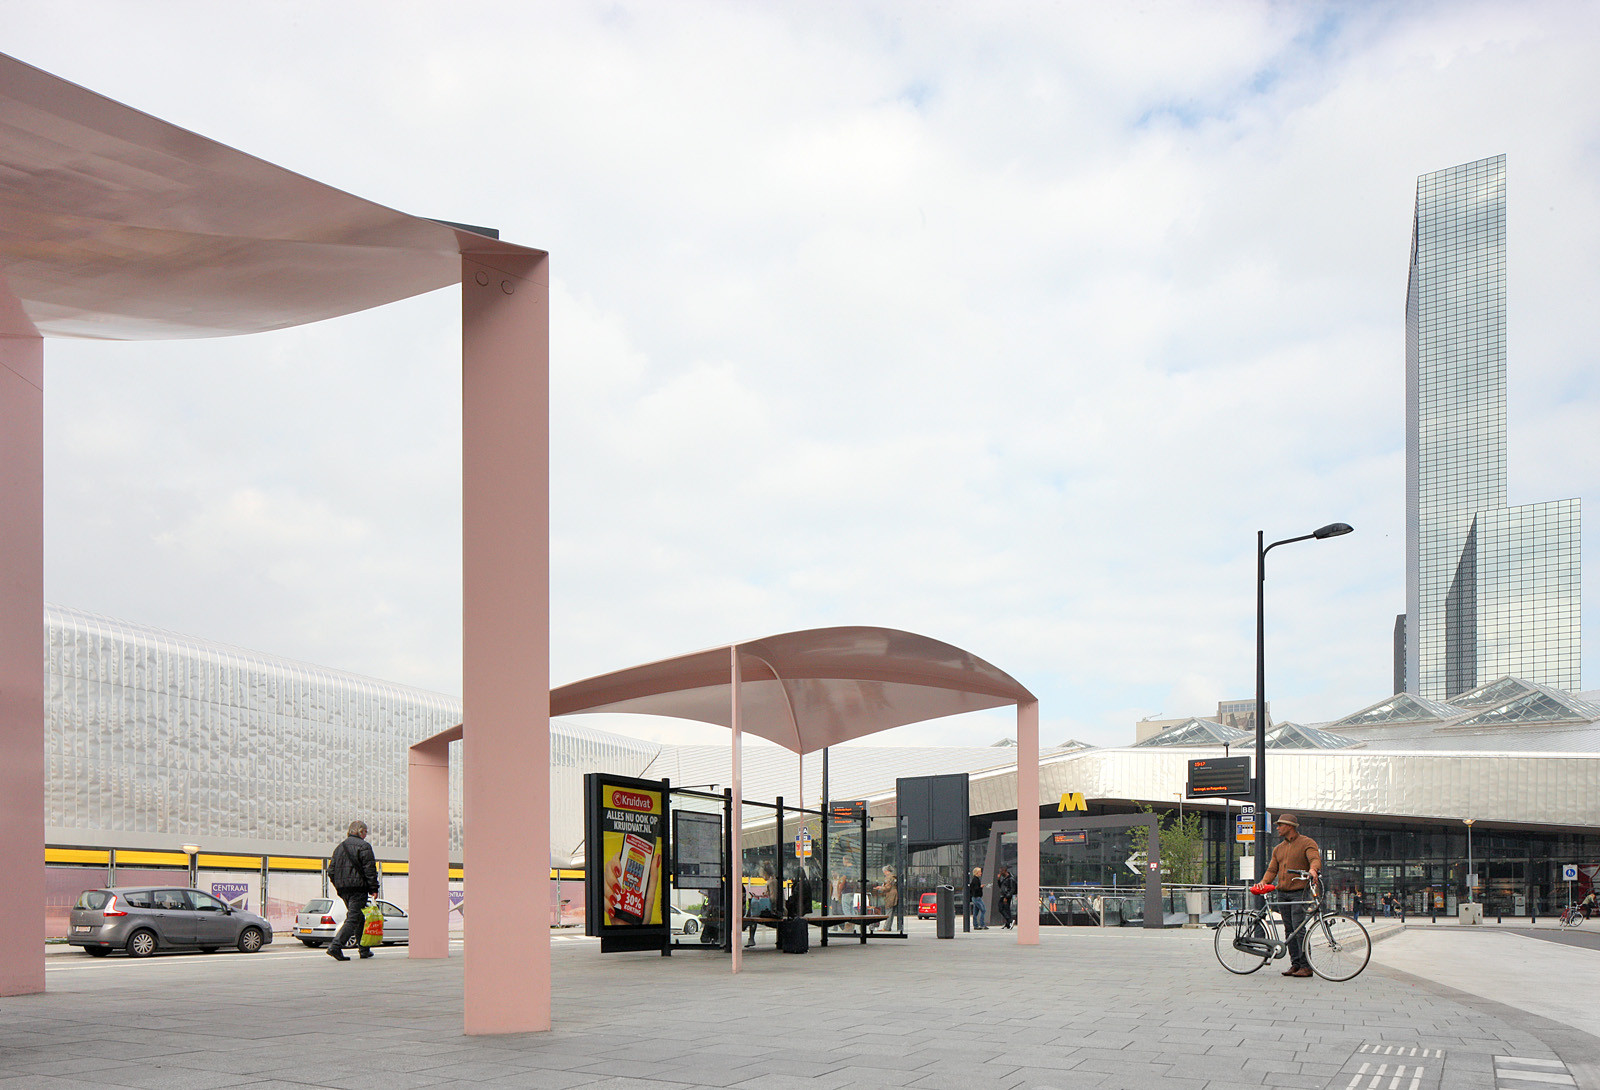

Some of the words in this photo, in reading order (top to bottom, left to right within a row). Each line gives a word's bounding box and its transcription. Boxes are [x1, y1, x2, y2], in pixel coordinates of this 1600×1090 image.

[622, 795, 651, 808] Kruidvat
[1242, 806, 1254, 814] BB
[606, 810, 624, 821] ALLES
[625, 812, 634, 822] NU
[635, 814, 649, 824] OOK
[649, 816, 658, 825] OP
[614, 821, 652, 833] KRUIDVAT.NL
[212, 884, 248, 892] CENTRAAL
[625, 893, 642, 909] 30%
[624, 904, 641, 915] KORTING
